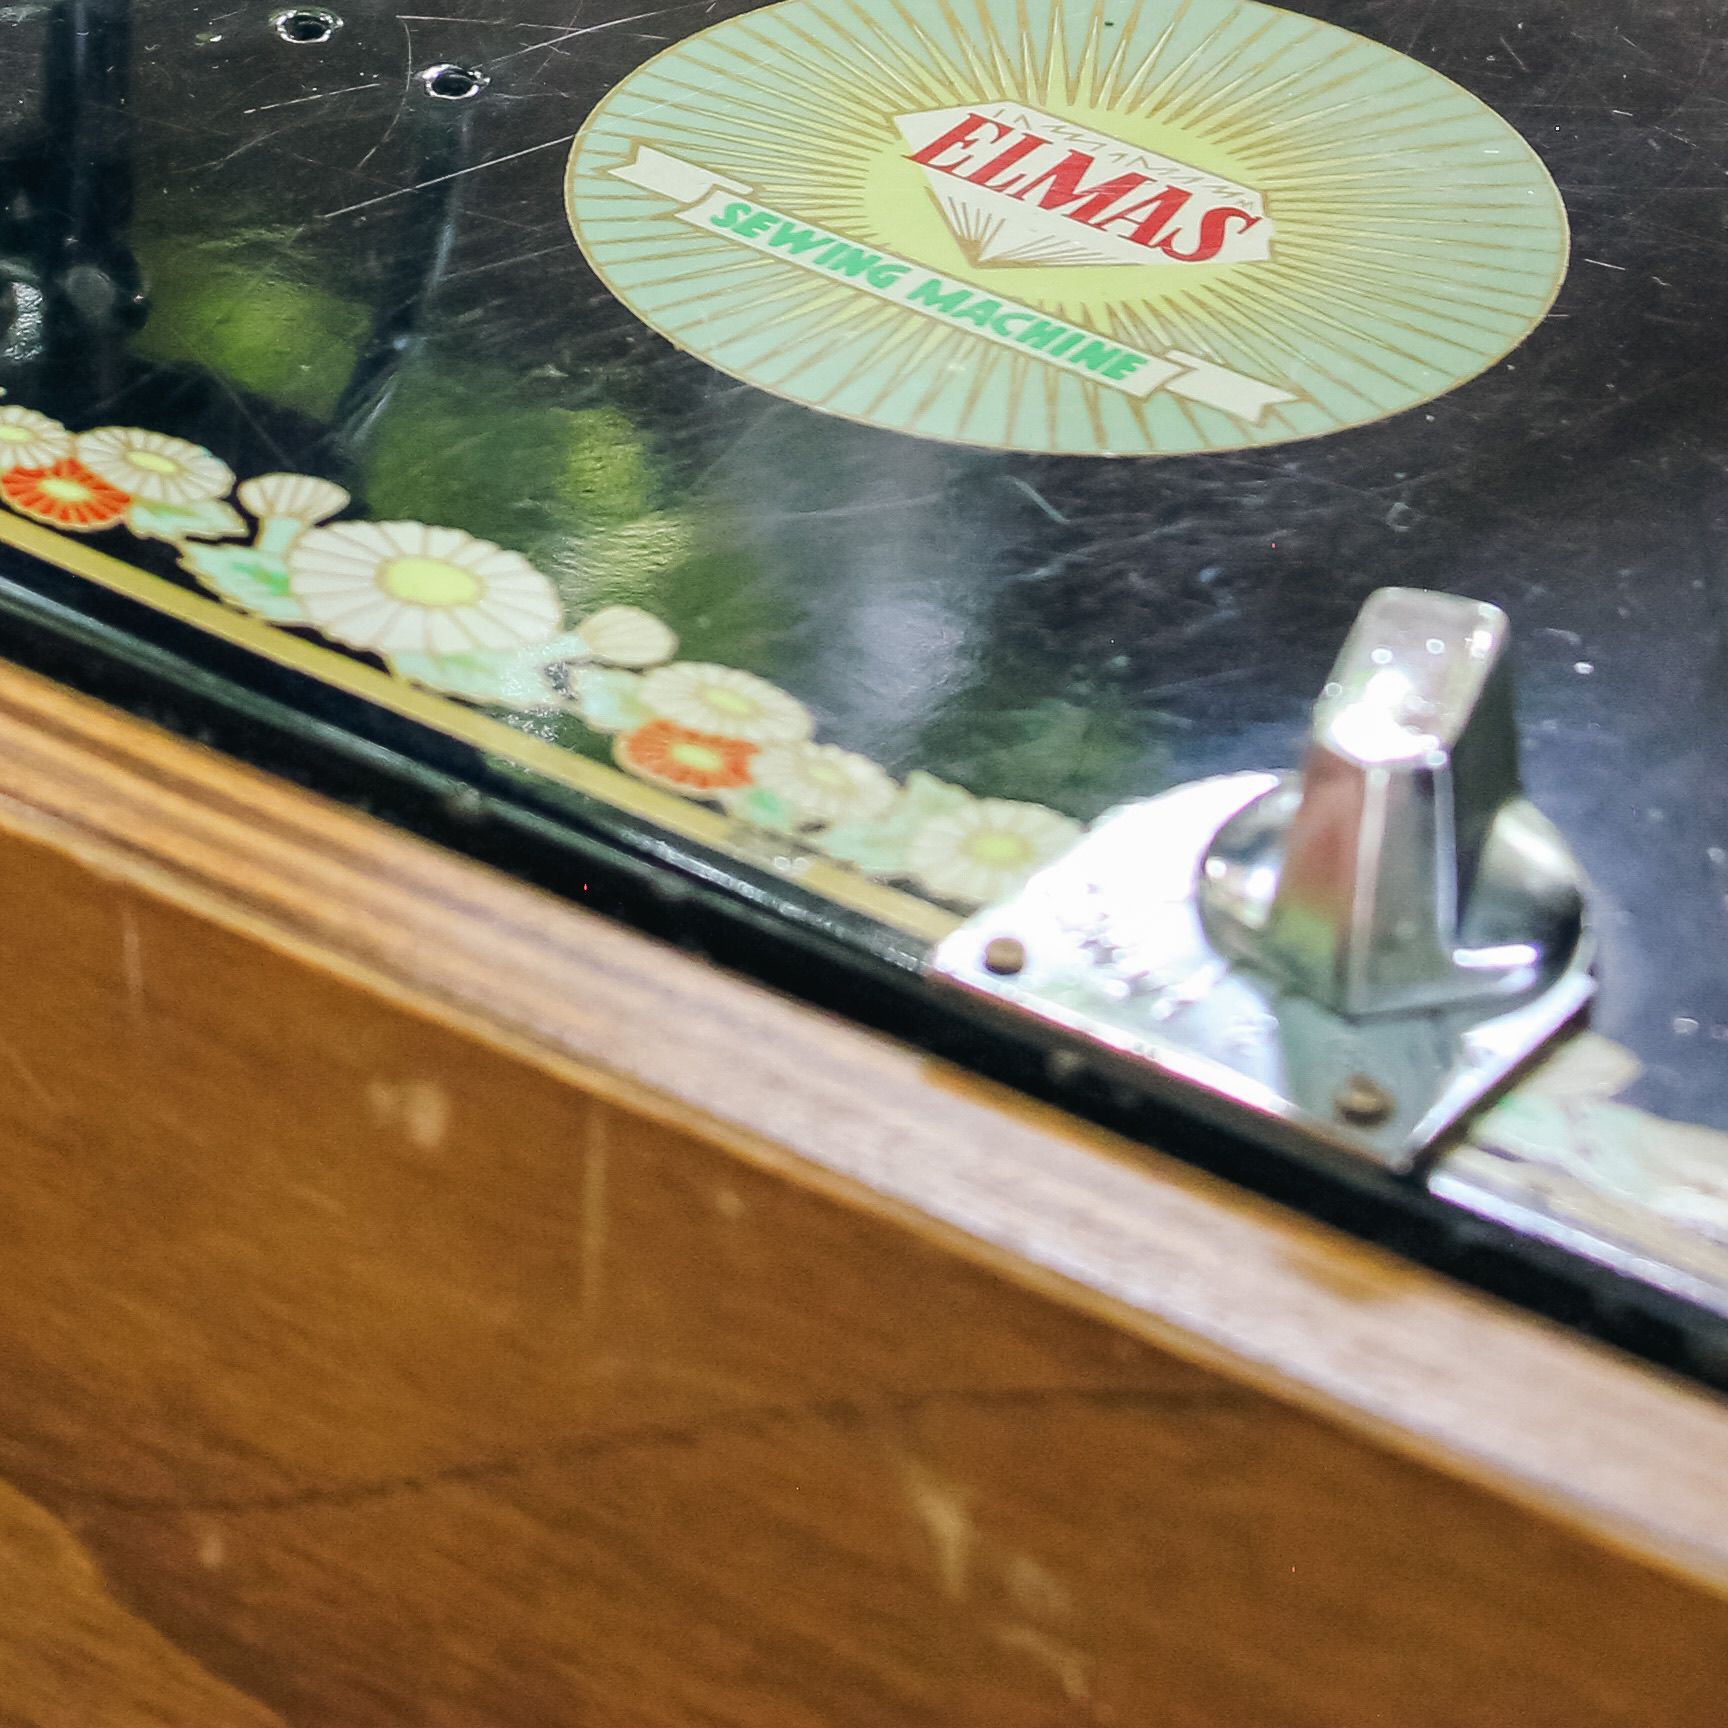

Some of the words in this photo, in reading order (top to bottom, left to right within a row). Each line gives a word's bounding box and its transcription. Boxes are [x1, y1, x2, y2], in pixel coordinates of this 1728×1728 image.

[903, 113, 1262, 262] ELMAS
[710, 201, 910, 290] SEWING
[907, 277, 1150, 382] MACHINE
